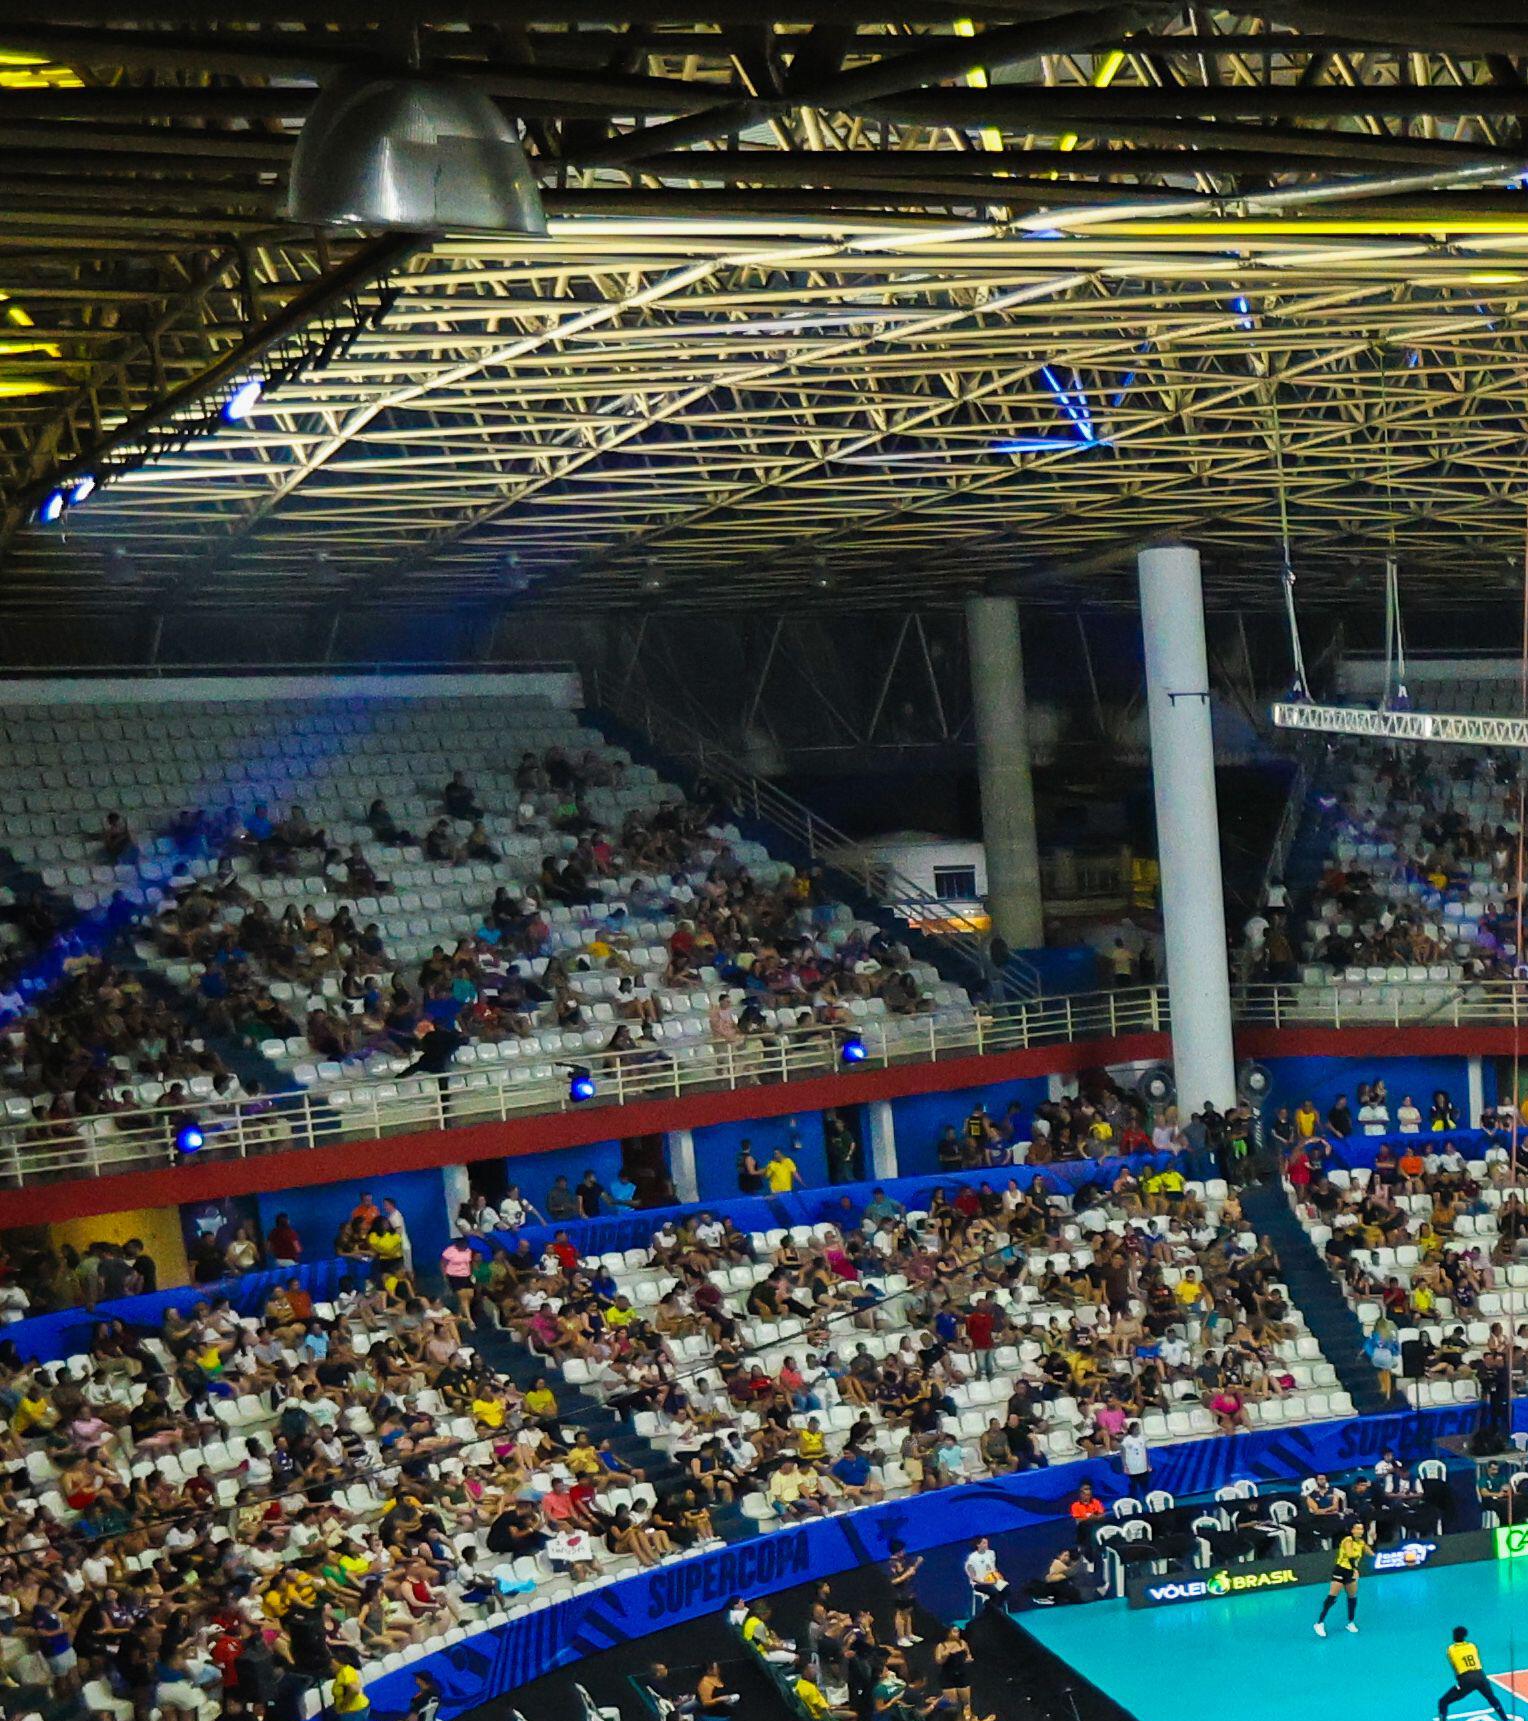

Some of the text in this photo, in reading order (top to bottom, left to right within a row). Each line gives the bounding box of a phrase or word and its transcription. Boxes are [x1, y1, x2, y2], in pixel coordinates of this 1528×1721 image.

[647, 1530, 809, 1620] SUPERCOPA
[1150, 1569, 1298, 1600] VÔLEI BRASIL
[1462, 1655, 1476, 1667] 18
